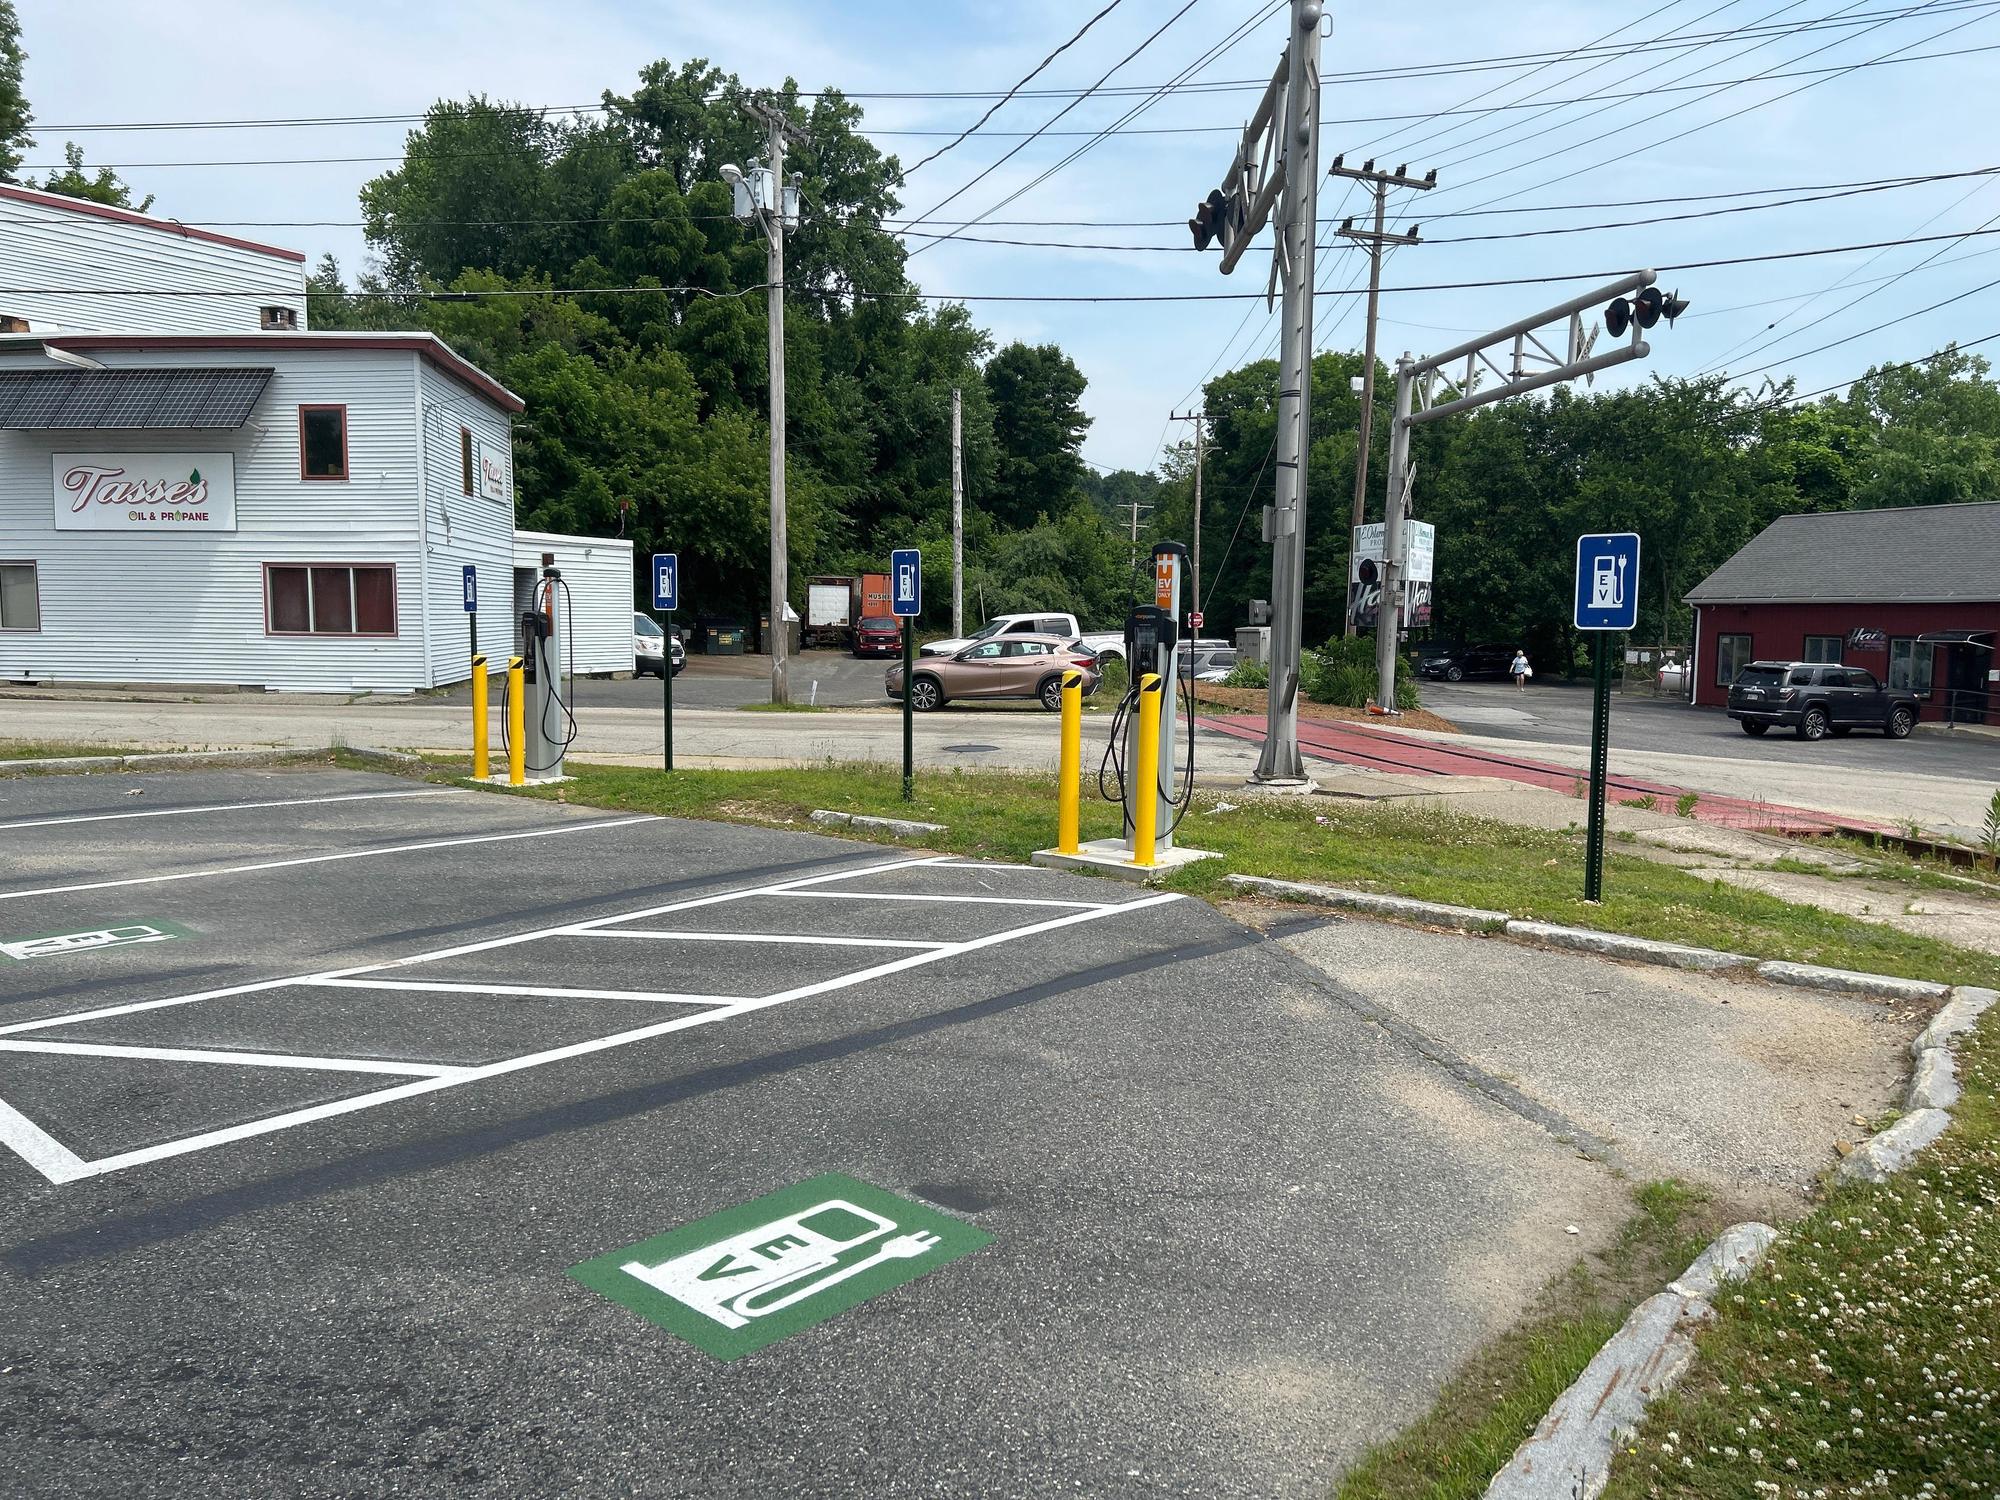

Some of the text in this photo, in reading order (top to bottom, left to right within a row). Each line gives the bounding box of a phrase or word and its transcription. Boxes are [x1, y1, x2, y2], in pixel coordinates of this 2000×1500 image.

[62, 465, 209, 512] Tasse's
[128, 510, 209, 521] OIL & PROPANE
[1158, 579, 1171, 588] EV
[1599, 574, 1609, 601] EV
[696, 1233, 811, 1281] EV
